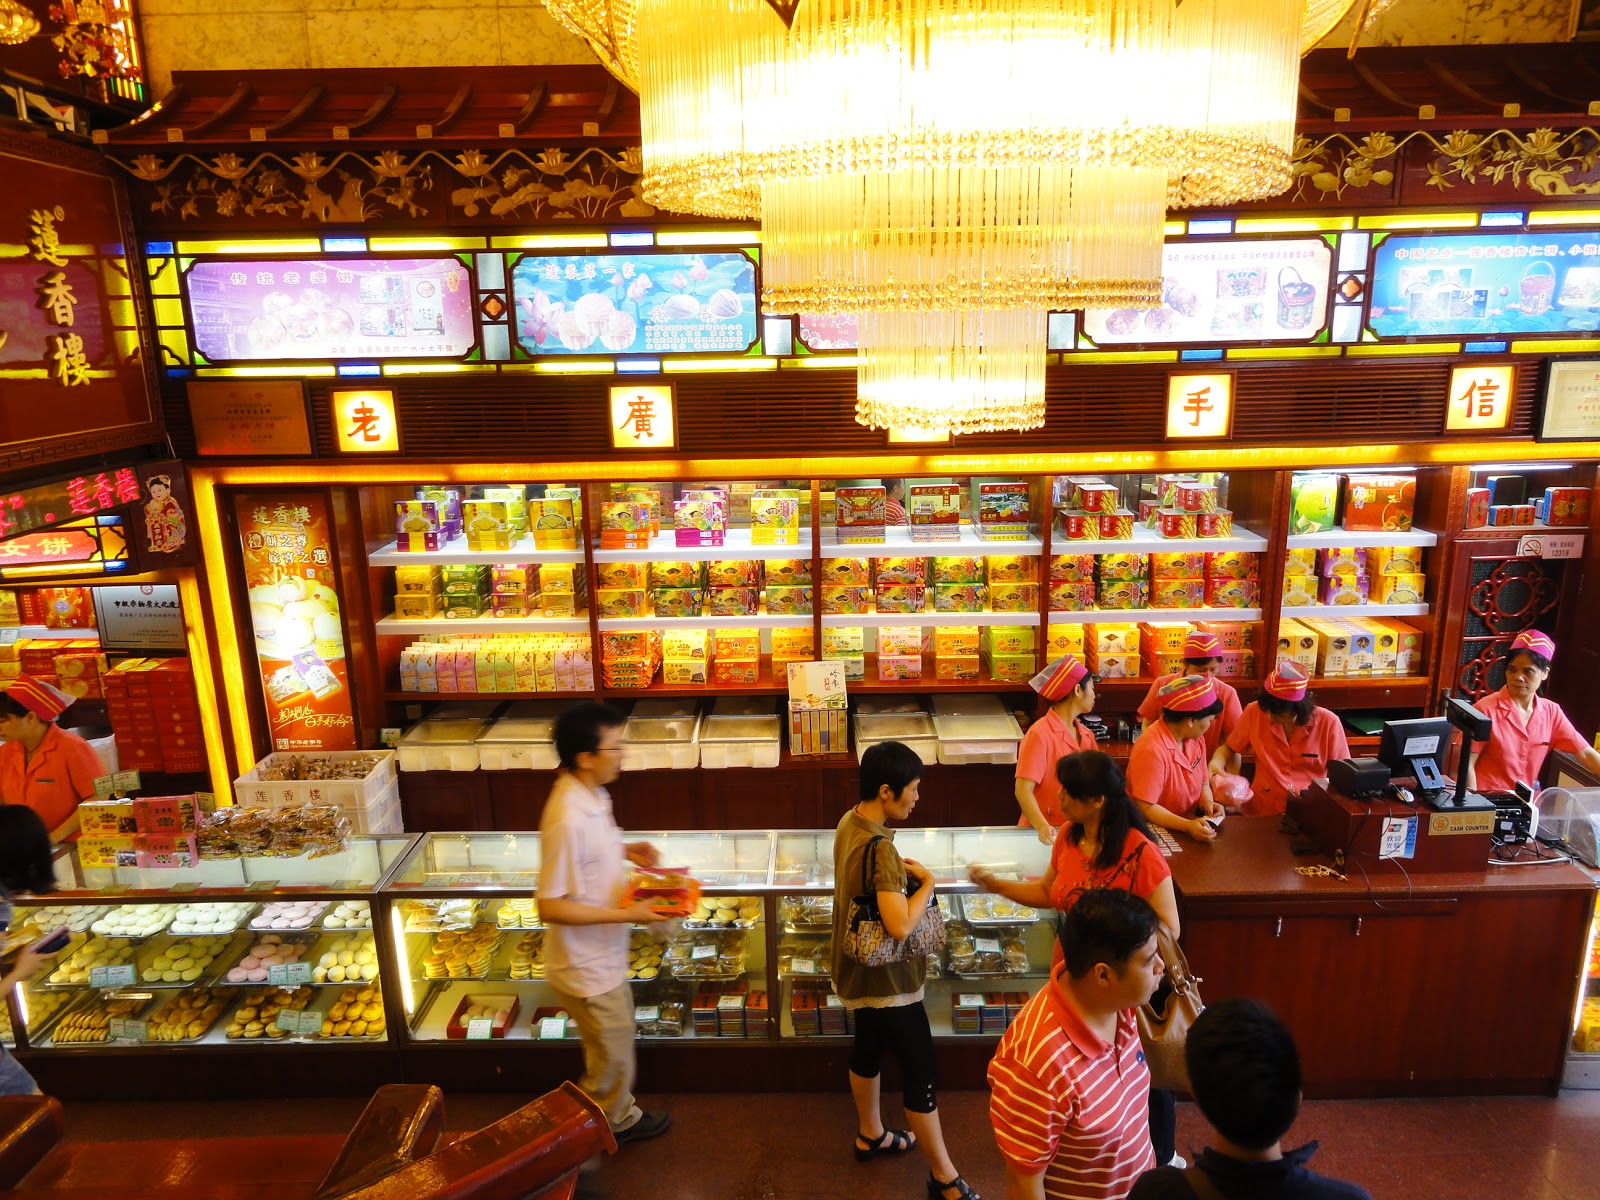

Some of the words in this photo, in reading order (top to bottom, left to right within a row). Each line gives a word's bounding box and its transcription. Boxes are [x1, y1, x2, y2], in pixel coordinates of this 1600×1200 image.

[231, 270, 354, 286] 传统老婆饼
[28, 207, 91, 386] 蓮香樓
[347, 401, 380, 442] 老
[619, 396, 657, 439] 廣
[1183, 386, 1215, 427] 手
[1458, 379, 1500, 418] 信
[113, 600, 180, 609] 市级非物质文化遗
[254, 788, 321, 802] 莲香楼
